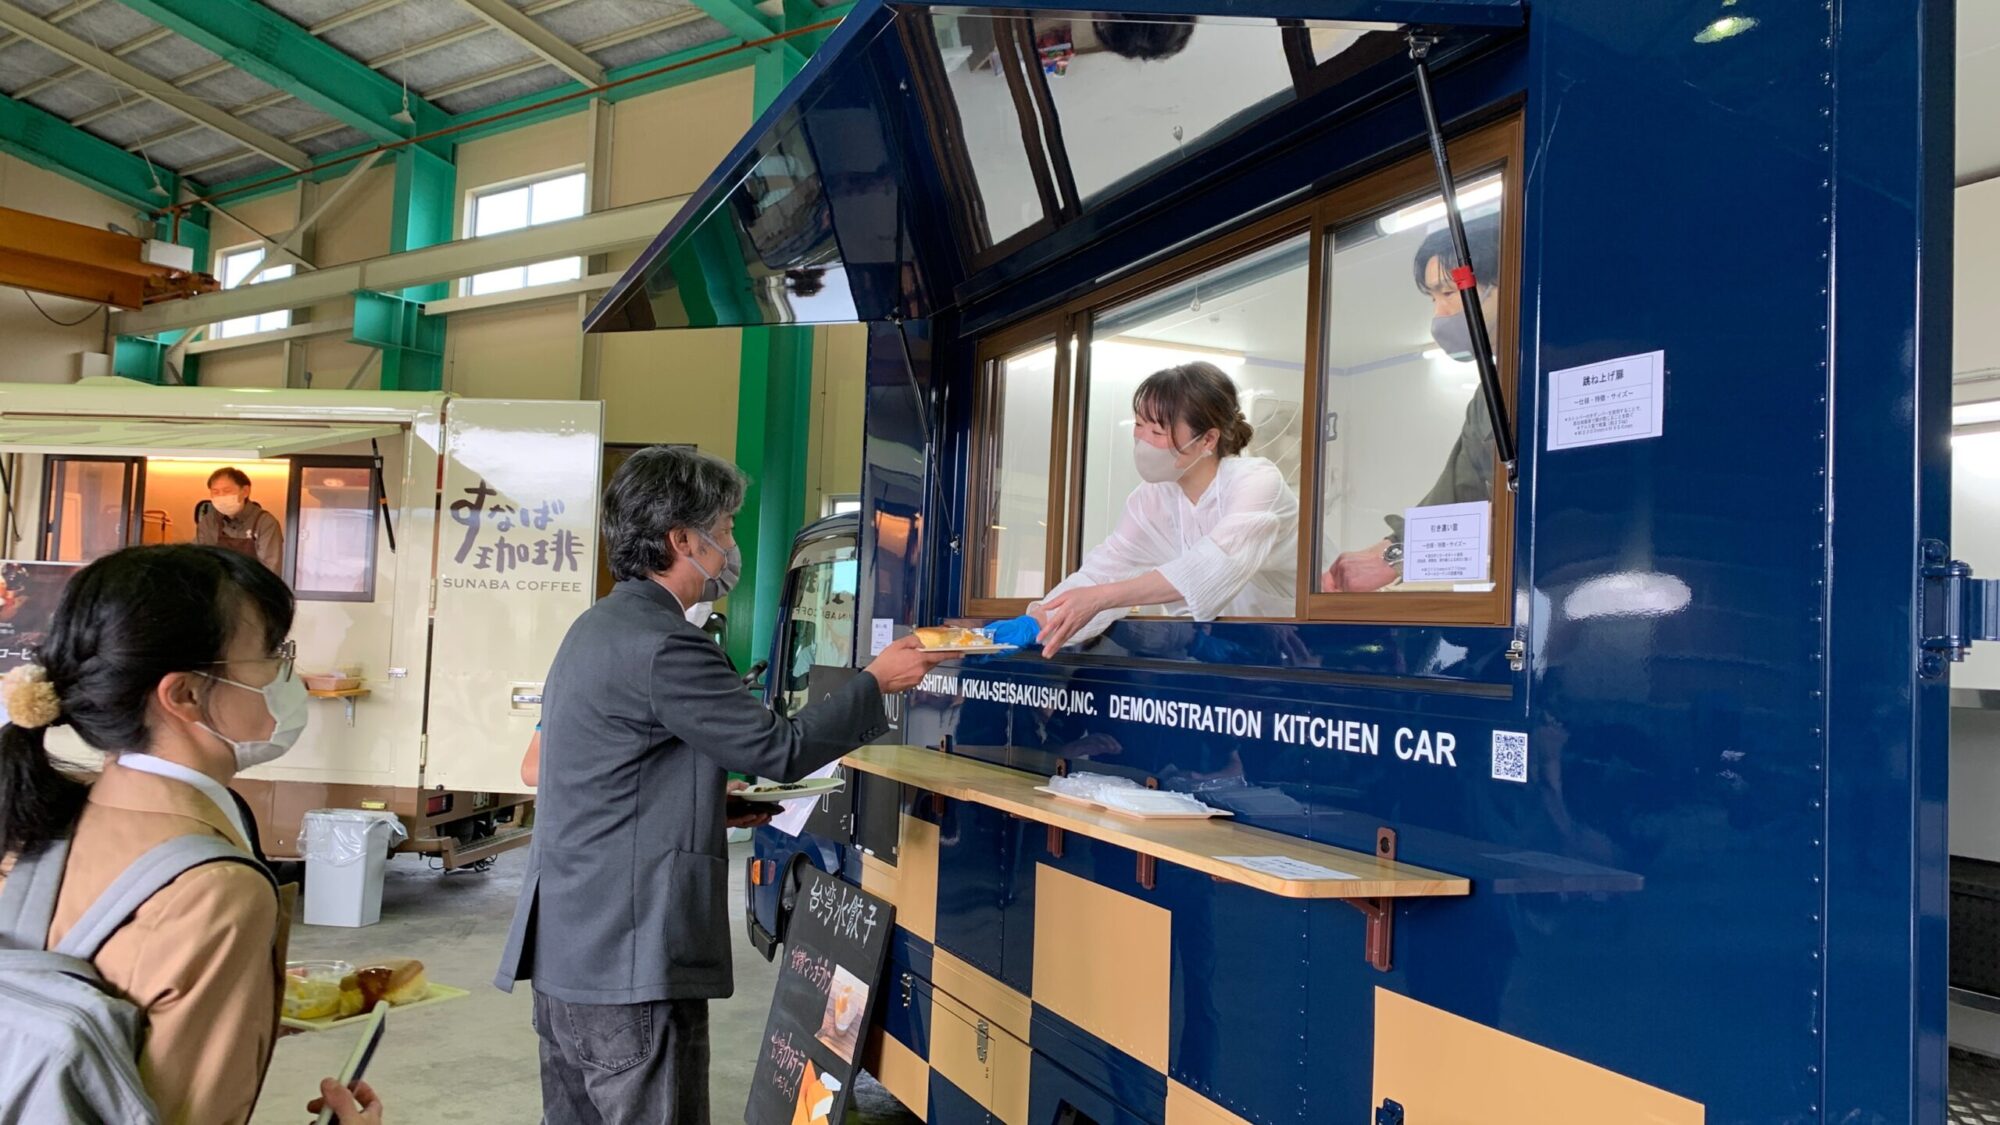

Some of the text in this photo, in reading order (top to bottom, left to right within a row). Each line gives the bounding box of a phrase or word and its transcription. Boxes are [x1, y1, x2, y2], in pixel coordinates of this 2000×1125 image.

[1582, 369, 1624, 387] 跳ね上げ扉
[450, 479, 566, 564] すなば
[473, 528, 585, 574] 珈琲
[443, 578, 583, 593] SUNABA COFFEE
[912, 673, 1457, 768] SHITANI KIKAI-SEISAKUSHO,INC. DEMONSTRATION KITCHEN CAR
[809, 875, 878, 949] 台湾水餃子
